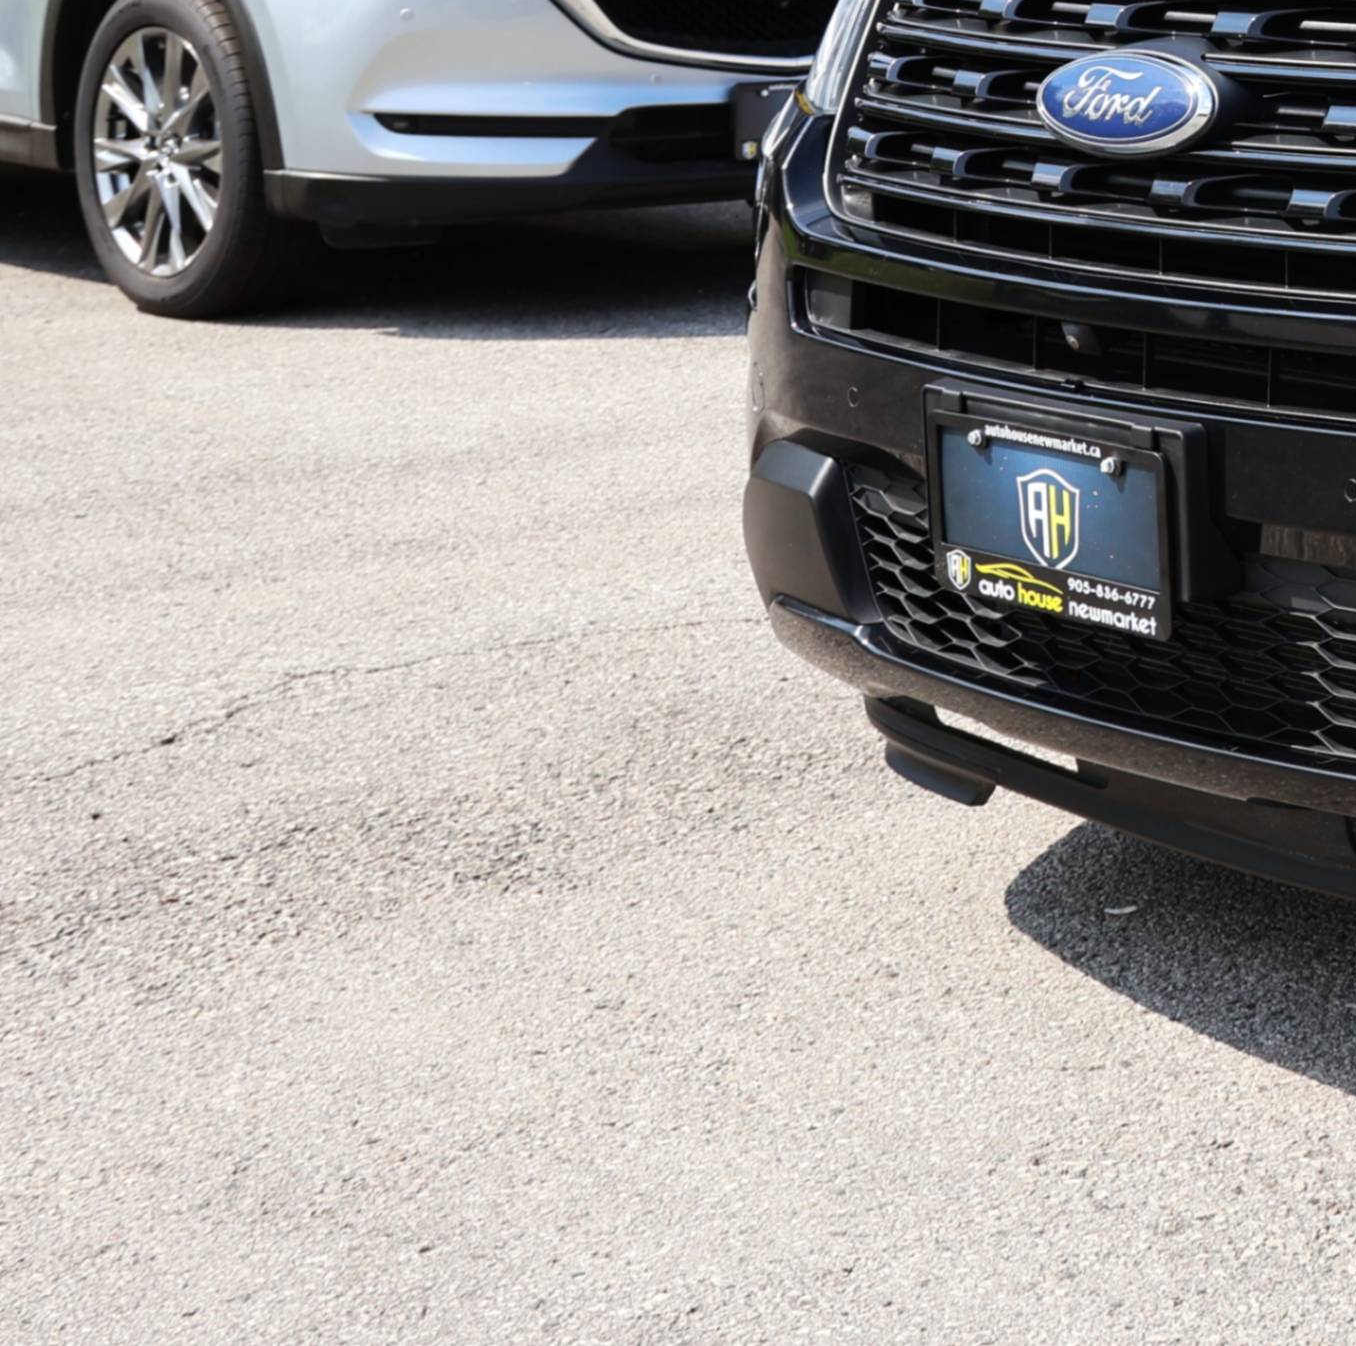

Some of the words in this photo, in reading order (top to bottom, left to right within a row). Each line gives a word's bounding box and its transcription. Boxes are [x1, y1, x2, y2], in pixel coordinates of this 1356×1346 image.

[1062, 65, 1162, 127] Ford
[983, 423, 1102, 459] autohousenewmarket.ca
[1027, 481, 1072, 559] AH
[1067, 577, 1156, 610] 905-836-6777
[1068, 600, 1158, 637] newmarket
